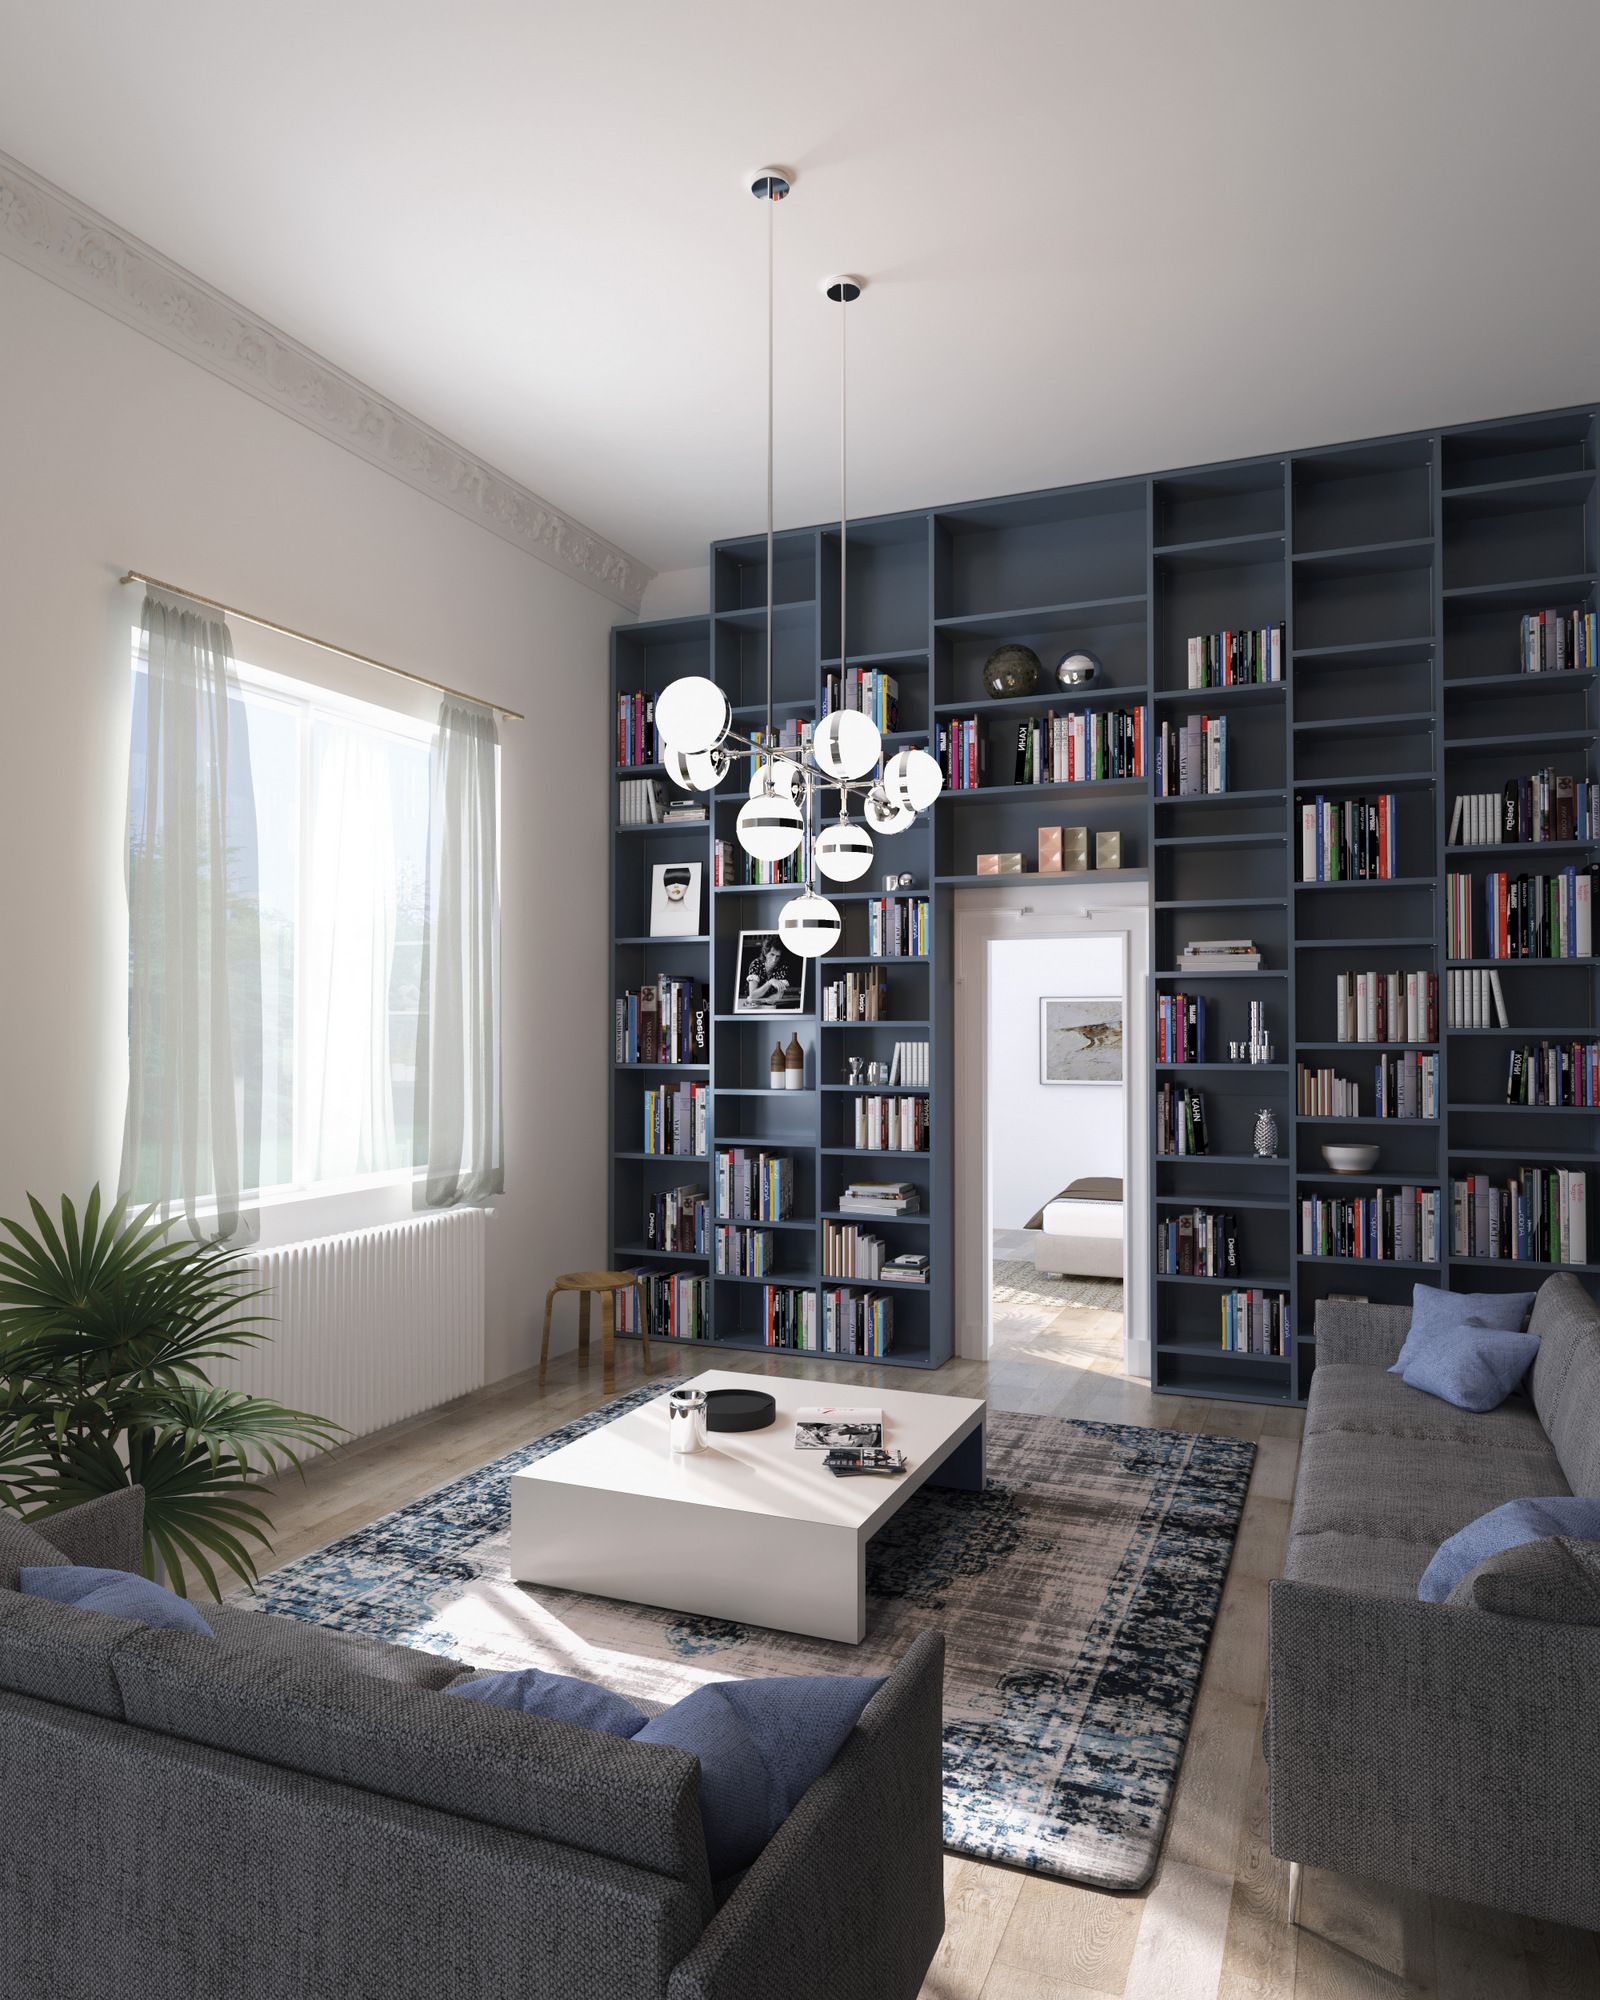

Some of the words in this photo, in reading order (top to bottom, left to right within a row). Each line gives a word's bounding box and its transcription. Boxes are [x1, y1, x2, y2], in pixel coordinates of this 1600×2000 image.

[858, 994, 866, 1013] Design
[696, 1010, 705, 1048] Design
[1192, 1098, 1201, 1122] KAHN
[1228, 1238, 1236, 1266] Design
